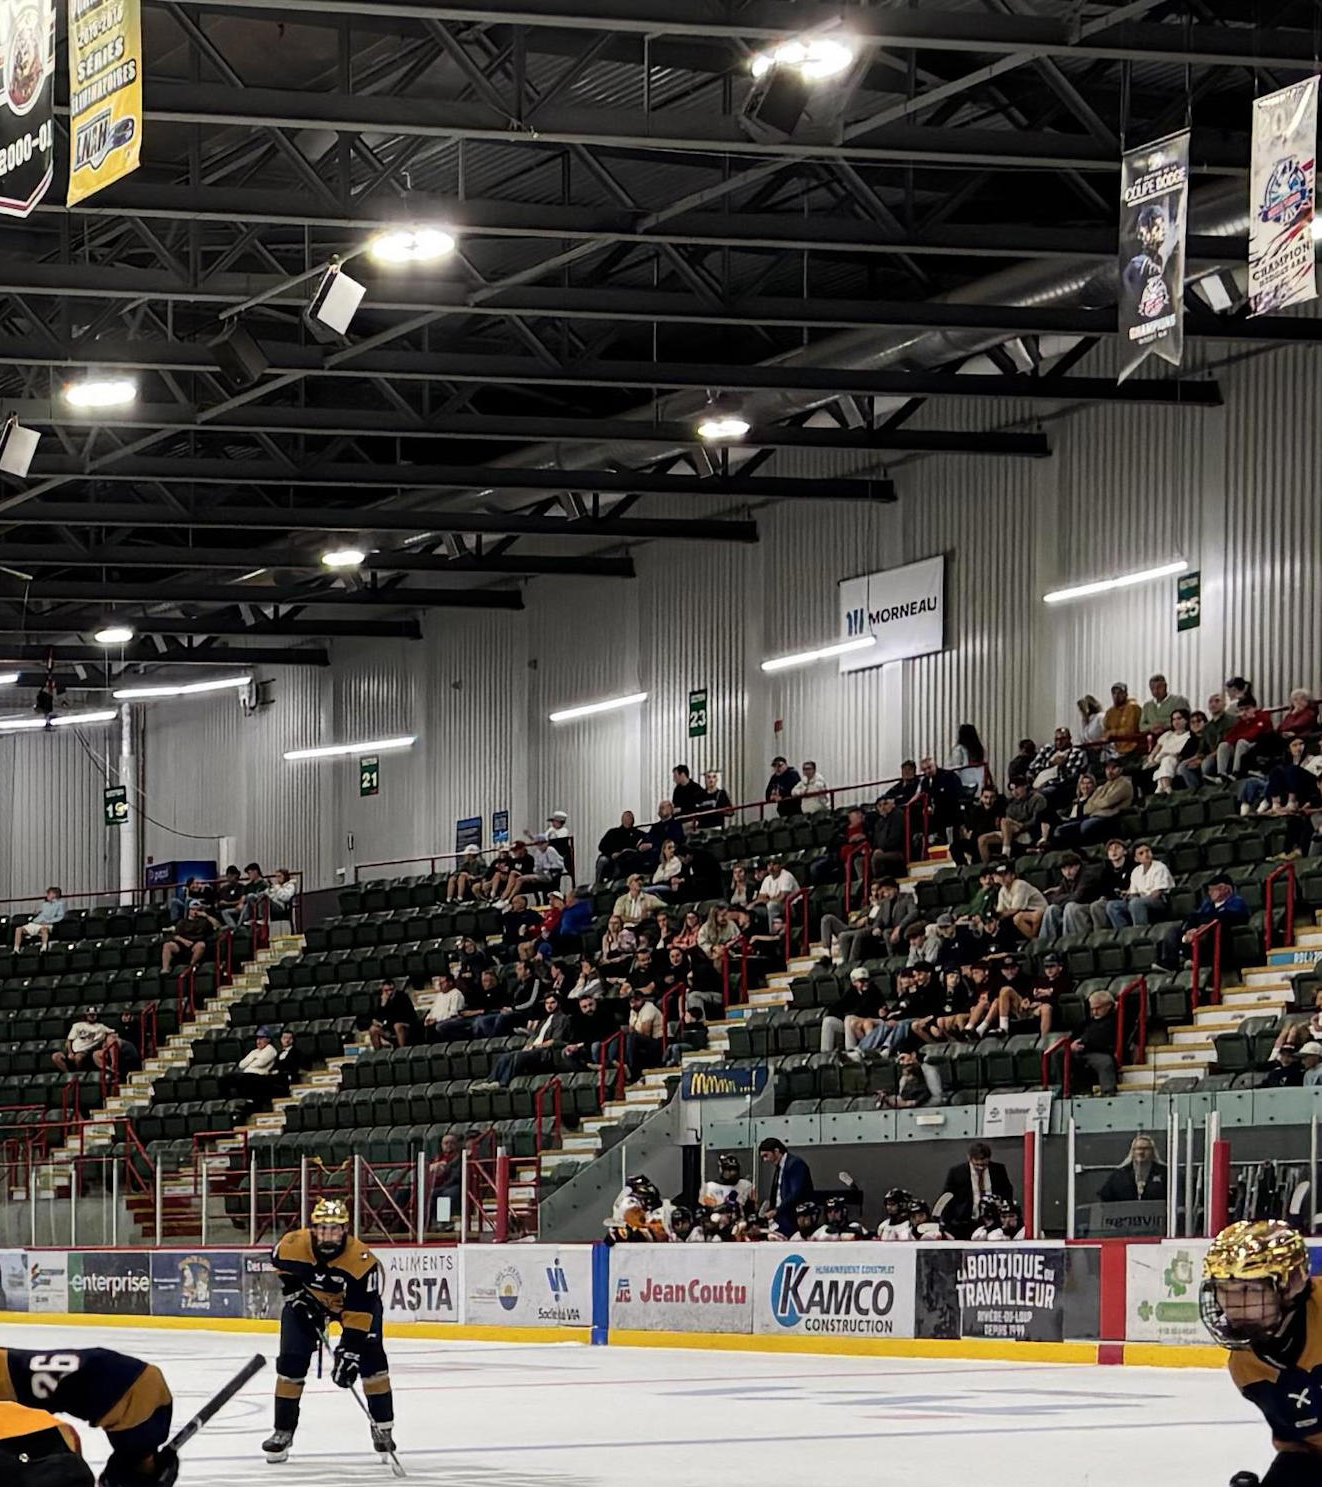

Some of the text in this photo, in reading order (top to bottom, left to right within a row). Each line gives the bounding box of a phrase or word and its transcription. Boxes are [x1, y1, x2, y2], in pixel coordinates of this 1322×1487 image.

[868, 596, 937, 624] MORNEAU
[690, 709, 706, 728] 23
[362, 772, 377, 788] 21
[390, 1255, 453, 1271] ALIMENTS
[966, 1253, 1045, 1281] BOUTIQUE
[71, 1270, 150, 1298] enterprise
[390, 1277, 453, 1311] ASTA
[640, 1278, 747, 1305] Jean Coutu
[778, 1264, 895, 1316] KAMCO
[955, 1283, 1055, 1309] TRAVAILLEUR
[805, 1318, 893, 1333] CONSTRUCTION
[977, 1309, 1033, 1324] RIVIÈRE-DU-LOUP
[984, 1324, 1007, 1337] DEPUIS
